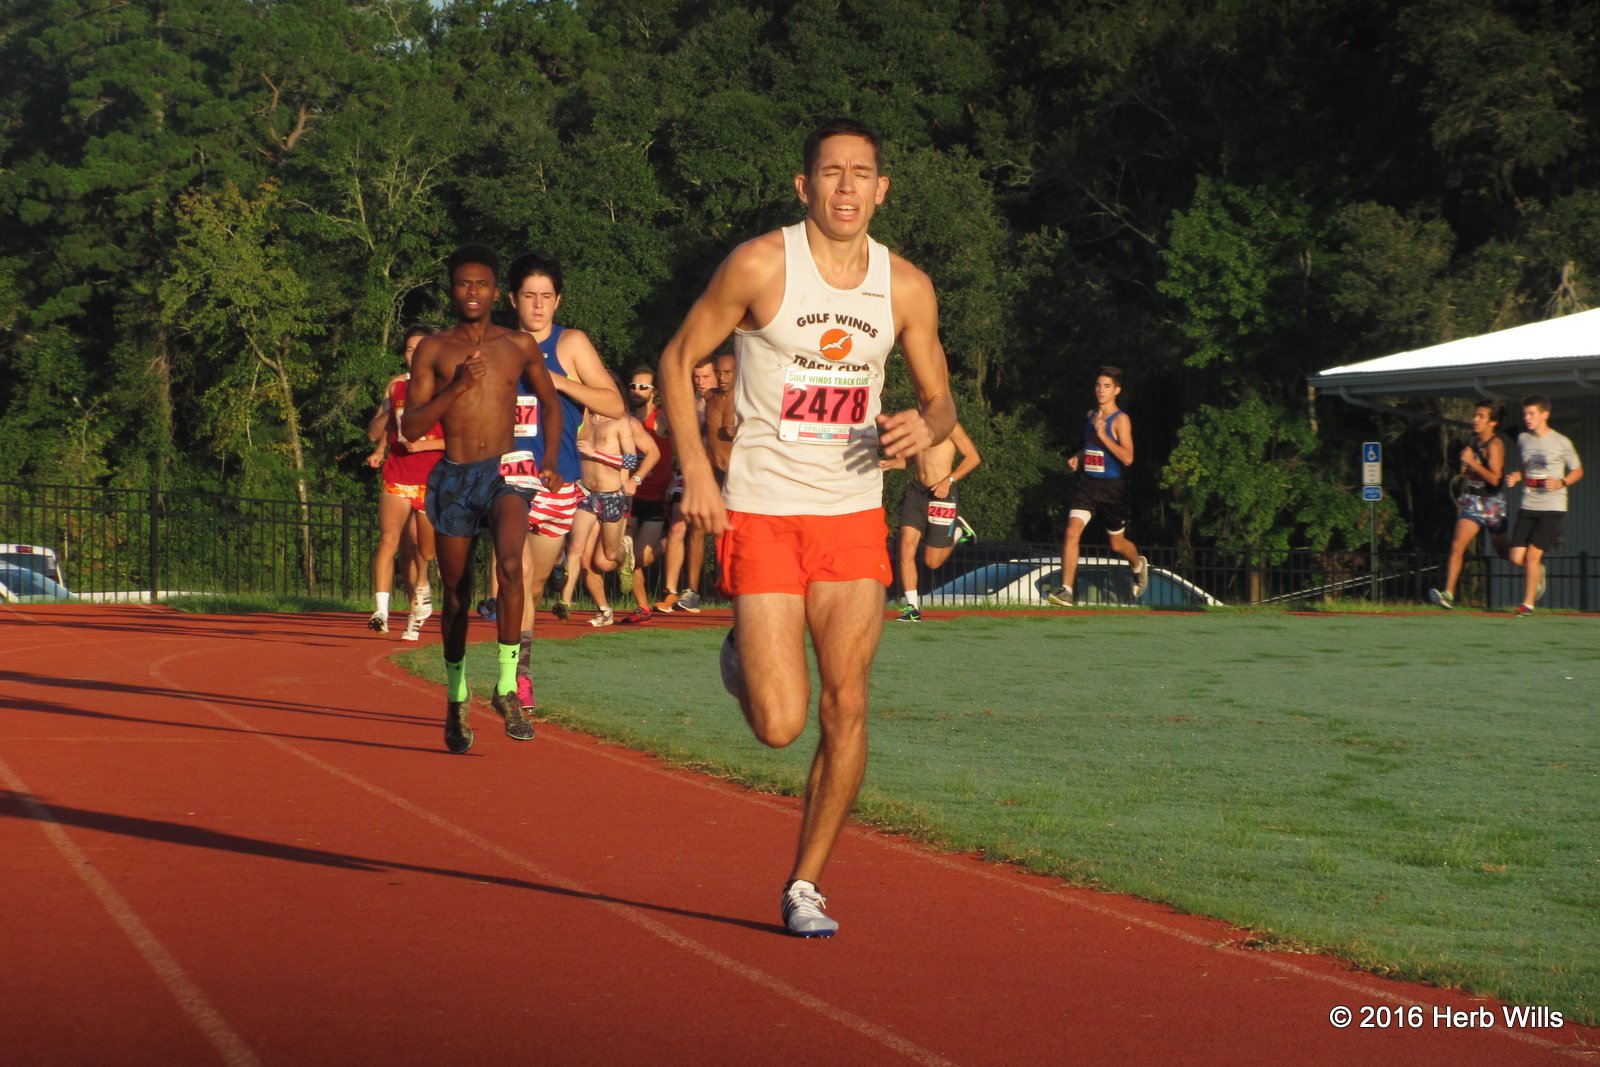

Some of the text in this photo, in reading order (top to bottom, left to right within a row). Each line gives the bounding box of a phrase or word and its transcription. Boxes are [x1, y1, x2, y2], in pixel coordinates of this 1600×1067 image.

[796, 313, 879, 339] GULF WINDS
[793, 354, 834, 371] TRACK
[788, 373, 870, 386] GULF WINDS TRACK CLUB
[784, 386, 868, 424] 2478
